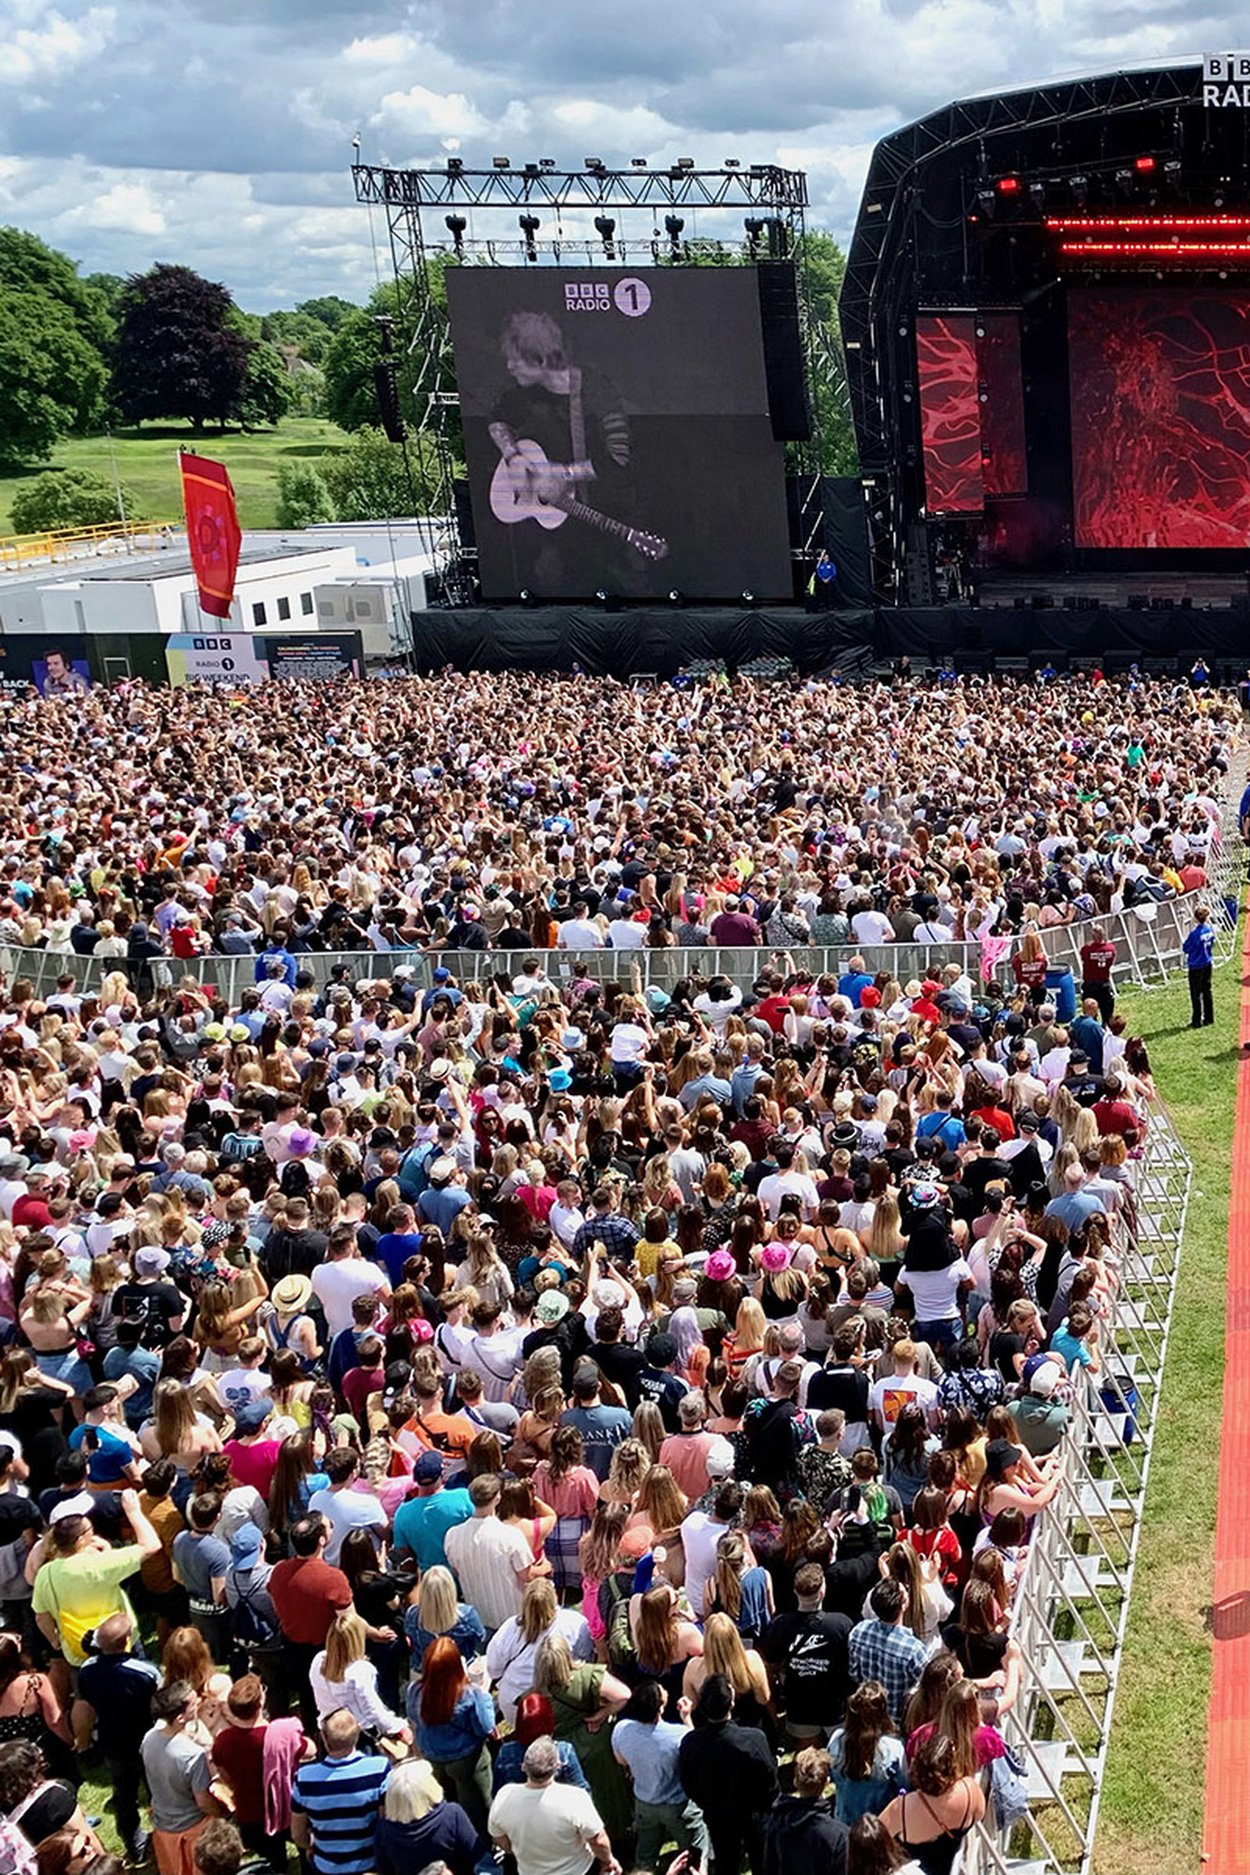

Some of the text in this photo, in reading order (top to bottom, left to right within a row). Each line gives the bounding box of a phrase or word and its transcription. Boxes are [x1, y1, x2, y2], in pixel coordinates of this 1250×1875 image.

[565, 284, 609, 298] BBC
[566, 299, 610, 311] RADIO
[194, 639, 232, 650] BBC
[196, 660, 220, 668] RADIO
[204, 674, 250, 683] WEEKEND
